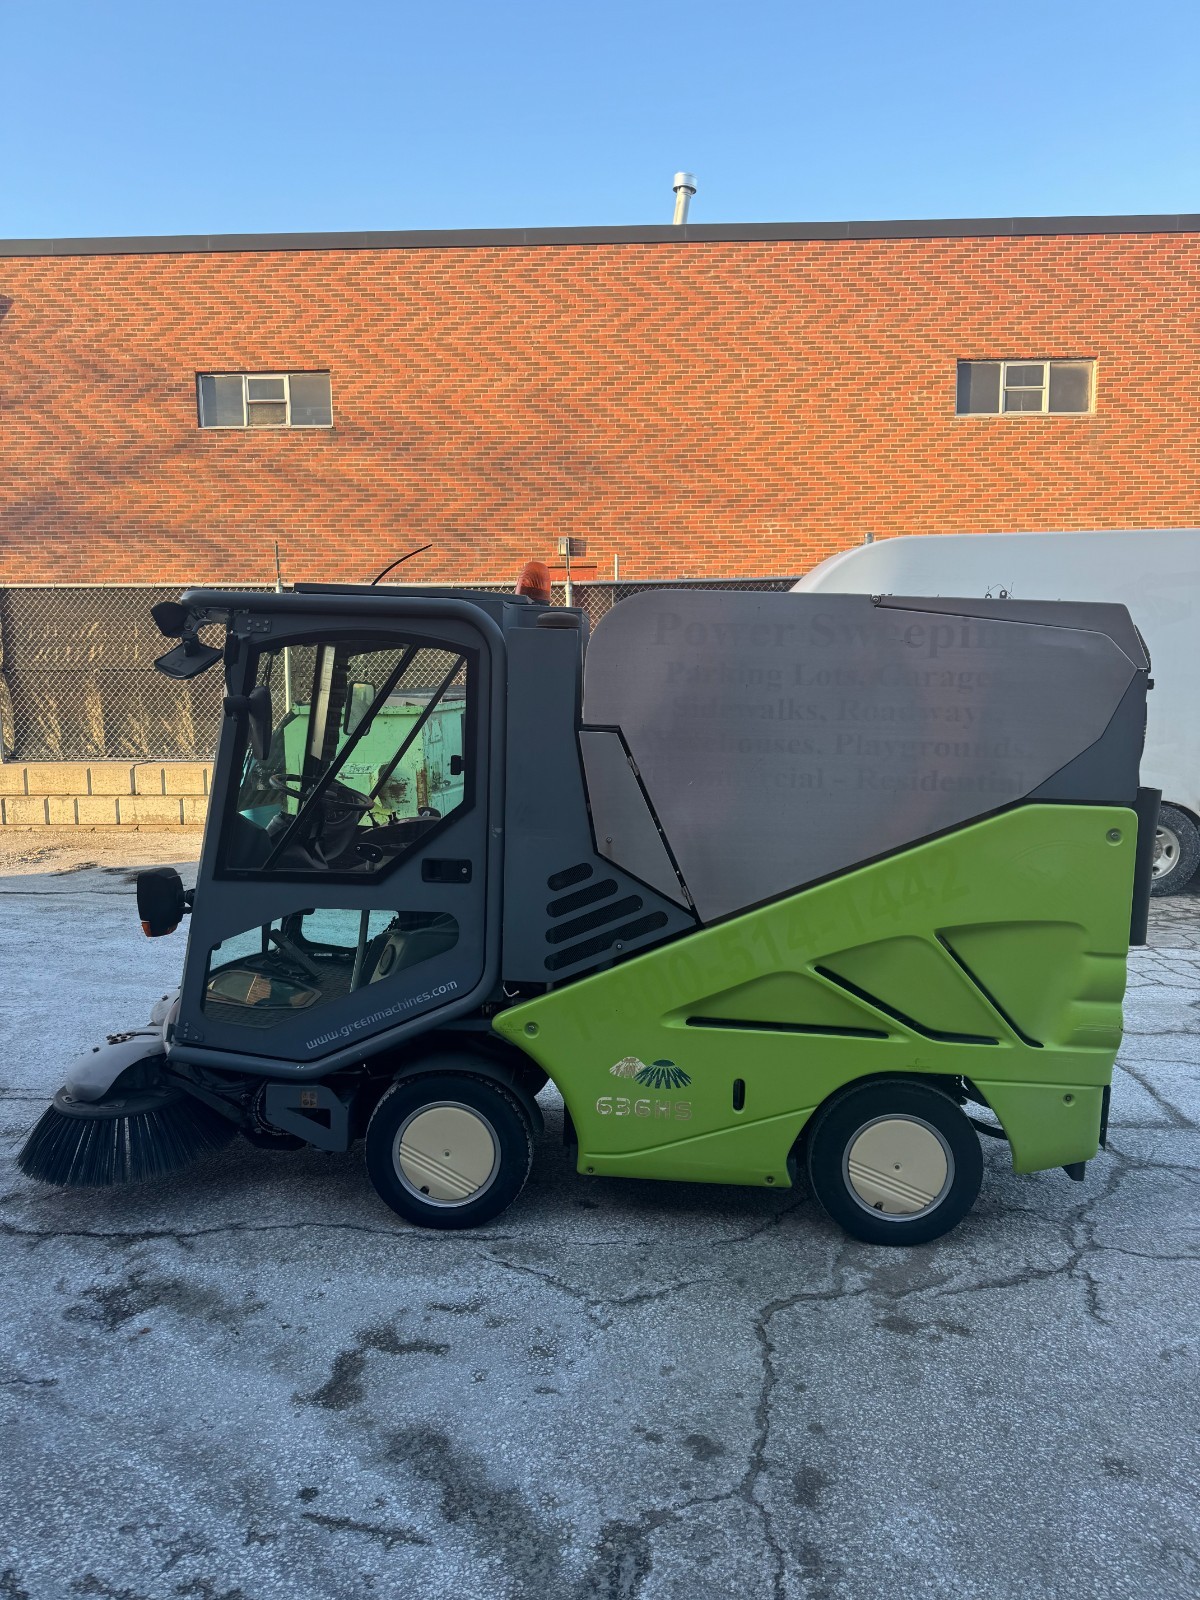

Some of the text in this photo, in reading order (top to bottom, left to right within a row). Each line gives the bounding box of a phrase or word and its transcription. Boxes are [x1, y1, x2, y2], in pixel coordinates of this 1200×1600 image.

[652, 612, 796, 648] Power
[561, 848, 972, 1041] 1-800-514-1442
[306, 980, 458, 1050] www.greenmachines.com
[596, 1097, 692, 1121] 636HS
